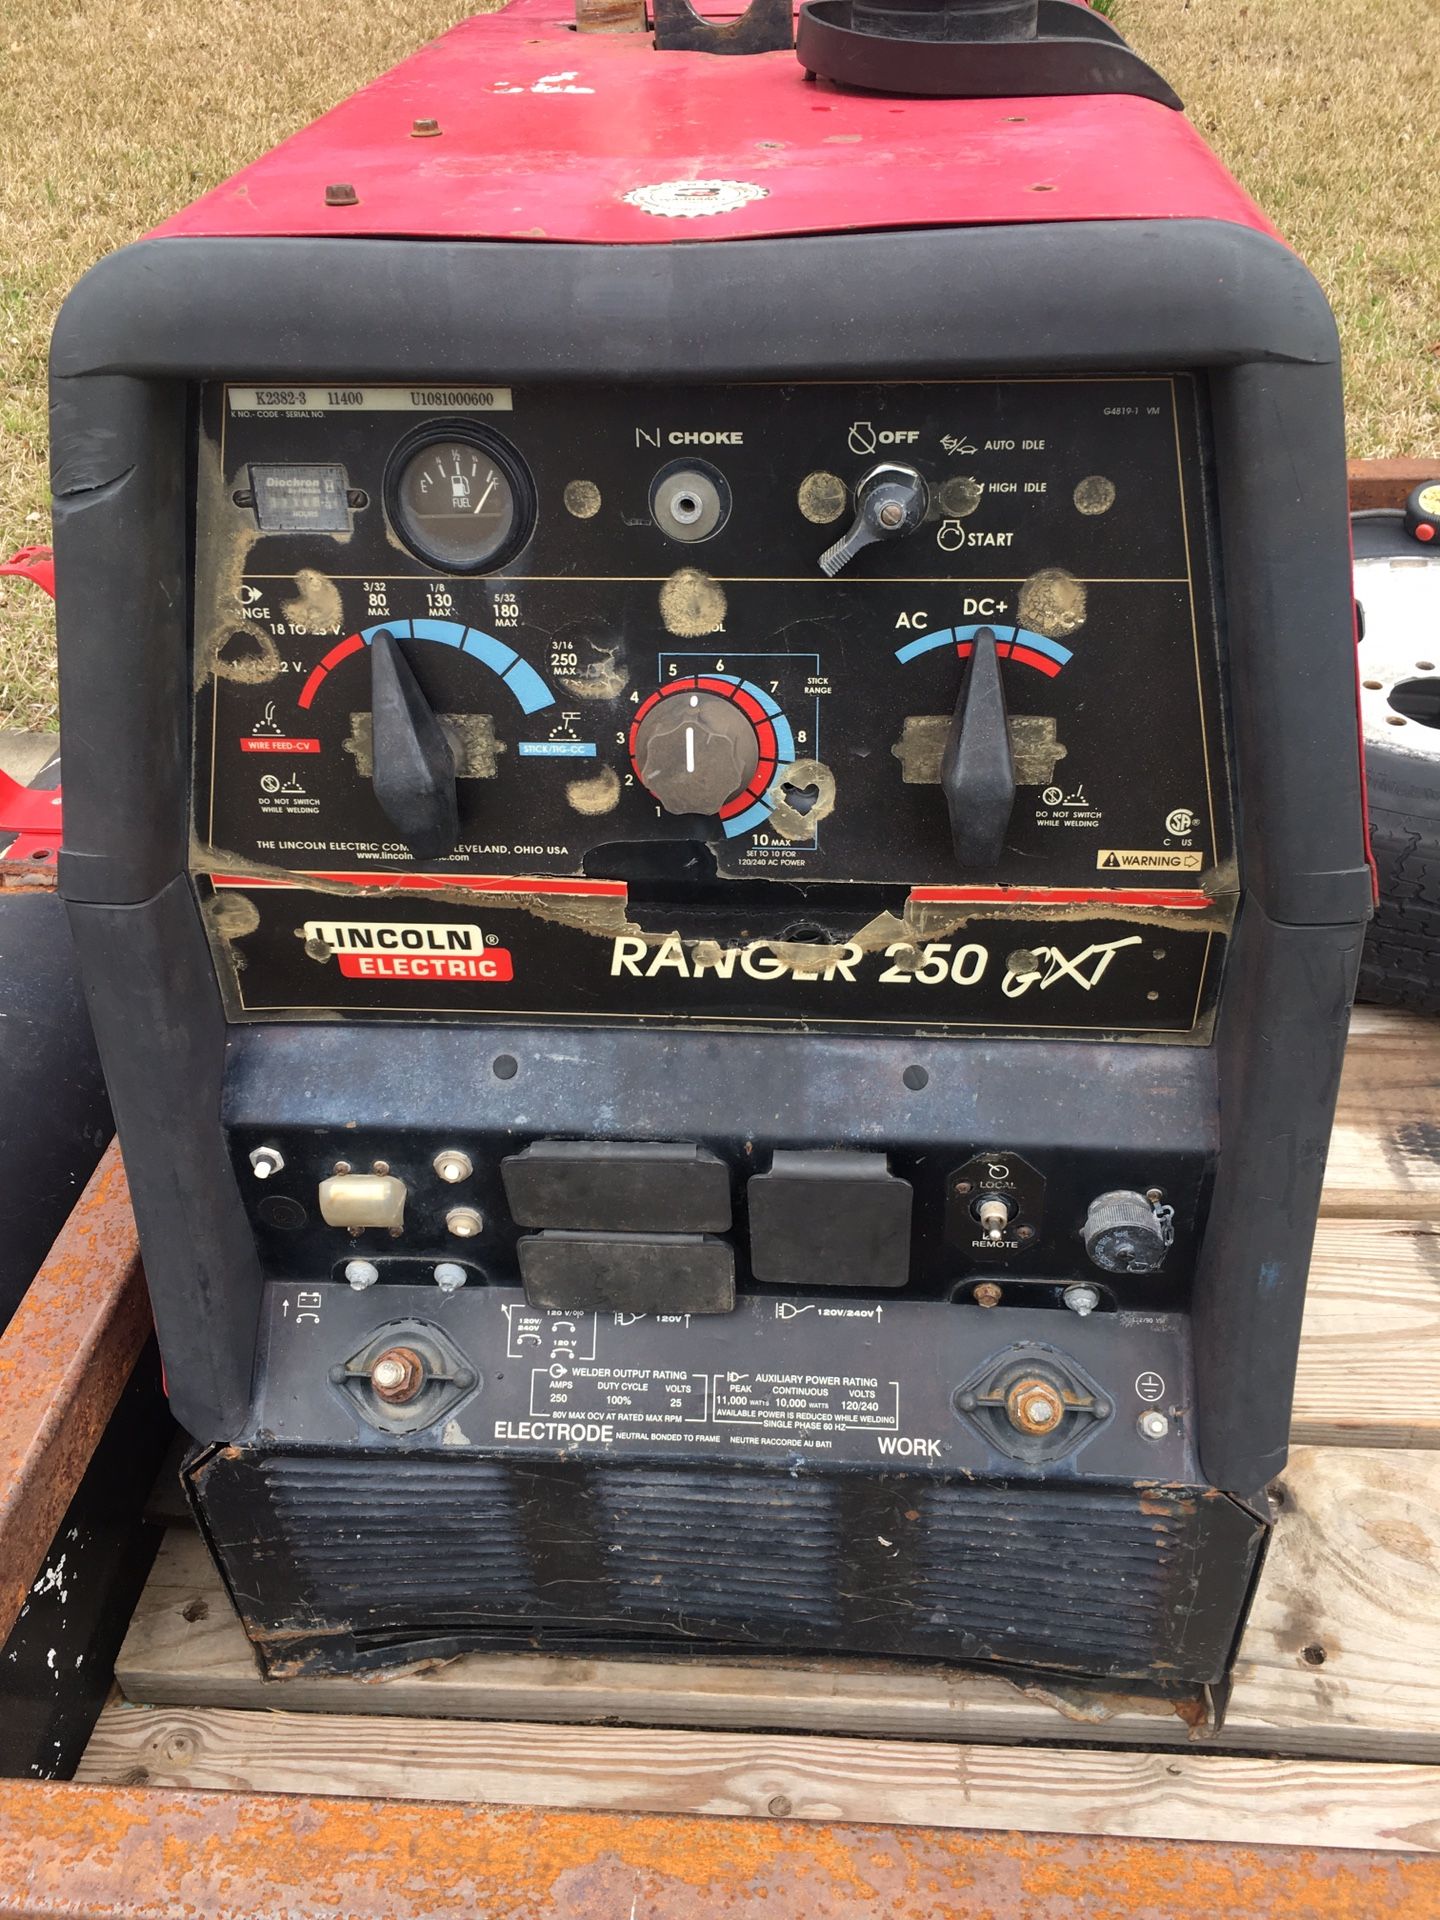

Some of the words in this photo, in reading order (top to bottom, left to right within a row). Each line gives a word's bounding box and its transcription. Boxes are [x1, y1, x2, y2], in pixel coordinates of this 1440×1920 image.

[256, 391, 306, 405] K2382-3
[328, 391, 363, 405] 11400
[411, 391, 494, 406] U1081000600
[1103, 407, 1139, 415] G4819-1
[668, 432, 743, 445] CHOKE
[879, 430, 920, 444] OFF
[984, 439, 1015, 450] AUTO
[1022, 440, 1045, 450] IDLE
[266, 478, 320, 487] Diochron
[420, 480, 428, 493] E
[988, 482, 1017, 493] HIGH
[1024, 483, 1047, 493] IDLE
[453, 498, 472, 508] FUEL
[967, 532, 1014, 546] START
[363, 583, 387, 591] 3/32
[429, 584, 445, 592] 1/8
[369, 594, 387, 606] 80
[426, 594, 452, 606] 130
[494, 594, 516, 602] 5/32
[367, 608, 390, 616] MAX
[429, 608, 451, 616] MAX
[492, 605, 519, 617] 180
[963, 598, 1008, 615] DC+
[495, 619, 518, 627] MAX
[895, 612, 928, 629] AC
[270, 624, 286, 634] 18
[288, 624, 307, 635] TO
[331, 624, 346, 635] V.
[552, 642, 573, 650] 3/16
[551, 654, 578, 666] 250
[716, 659, 724, 671] 6
[292, 662, 307, 673] V.
[553, 668, 576, 676] MAX
[669, 664, 677, 676] 5
[770, 681, 779, 693] 7
[807, 677, 829, 685] STICK
[630, 691, 639, 703] 4
[804, 687, 832, 695] RANGE
[616, 732, 625, 744] 3
[797, 731, 807, 743] 8
[248, 741, 269, 749] WIRE
[272, 742, 310, 750] FEED-CV
[523, 745, 585, 753] STICK/TIG-CC
[625, 774, 633, 786] 2
[655, 807, 661, 817] 1
[752, 834, 769, 846] 10
[771, 839, 791, 847] MAX
[1163, 838, 1171, 846] C
[1181, 838, 1192, 846] US
[256, 841, 275, 849] THE
[279, 841, 327, 850] LINCOLN
[330, 842, 379, 851] ELECTRIC
[453, 845, 511, 855] LEVELAND,
[514, 846, 544, 854] OHIO
[547, 846, 569, 854] USA
[746, 850, 758, 858] SET
[759, 850, 769, 858] TO
[1121, 855, 1181, 867] WARNING
[315, 927, 473, 951] LINCOLN
[359, 957, 498, 977] ELECTRIC
[878, 942, 989, 986] 250
[980, 1181, 1016, 1189] LOCAL
[972, 1240, 1019, 1249] REMOTE
[818, 1309, 874, 1317] 120V/240V
[572, 1367, 611, 1377] WELDER
[613, 1369, 650, 1378] OUTPUT
[653, 1370, 687, 1380] RATING
[755, 1373, 802, 1384] AUXILIARY
[805, 1375, 840, 1385] POWER
[842, 1377, 878, 1387] RATING
[549, 1381, 573, 1389] AMPS
[597, 1382, 620, 1391] DUTY
[621, 1382, 648, 1391] CYCLE
[665, 1384, 691, 1393] VOLTS
[730, 1384, 752, 1393] PEAK
[772, 1386, 829, 1396] CONTINUOUS
[849, 1389, 876, 1398] VOLTS
[550, 1394, 567, 1403] 250
[606, 1395, 632, 1405] 100%
[670, 1398, 682, 1407] 25
[716, 1395, 747, 1406] 11,000
[775, 1398, 806, 1408] 10,000
[841, 1401, 878, 1411] 120/240
[552, 1411, 567, 1419] 80V
[568, 1411, 586, 1420] MAX
[587, 1412, 605, 1421] OCV
[607, 1412, 616, 1420] AT
[617, 1413, 644, 1422] RATED
[646, 1414, 663, 1422] MAX
[665, 1414, 682, 1423] RPM
[716, 1409, 756, 1418] AVAILABLE
[758, 1410, 785, 1419] POWER
[787, 1411, 794, 1419] IS
[795, 1412, 833, 1421] REDUCED
[834, 1413, 858, 1422] WHILE
[860, 1415, 895, 1424] WELDING
[494, 1421, 614, 1442] ELECTRODE
[763, 1420, 792, 1429] SINGLE
[794, 1421, 822, 1430] PHASE
[823, 1422, 832, 1431] 60
[834, 1423, 846, 1431] HZ
[616, 1432, 649, 1440] NEUTRAL
[651, 1433, 681, 1442] BONDED
[695, 1435, 720, 1443] FRAME
[730, 1436, 759, 1444] NEUTRE
[761, 1437, 802, 1446] RACCORDE
[803, 1439, 813, 1447] AU
[815, 1440, 832, 1448] BATI
[878, 1436, 942, 1456] WORK
